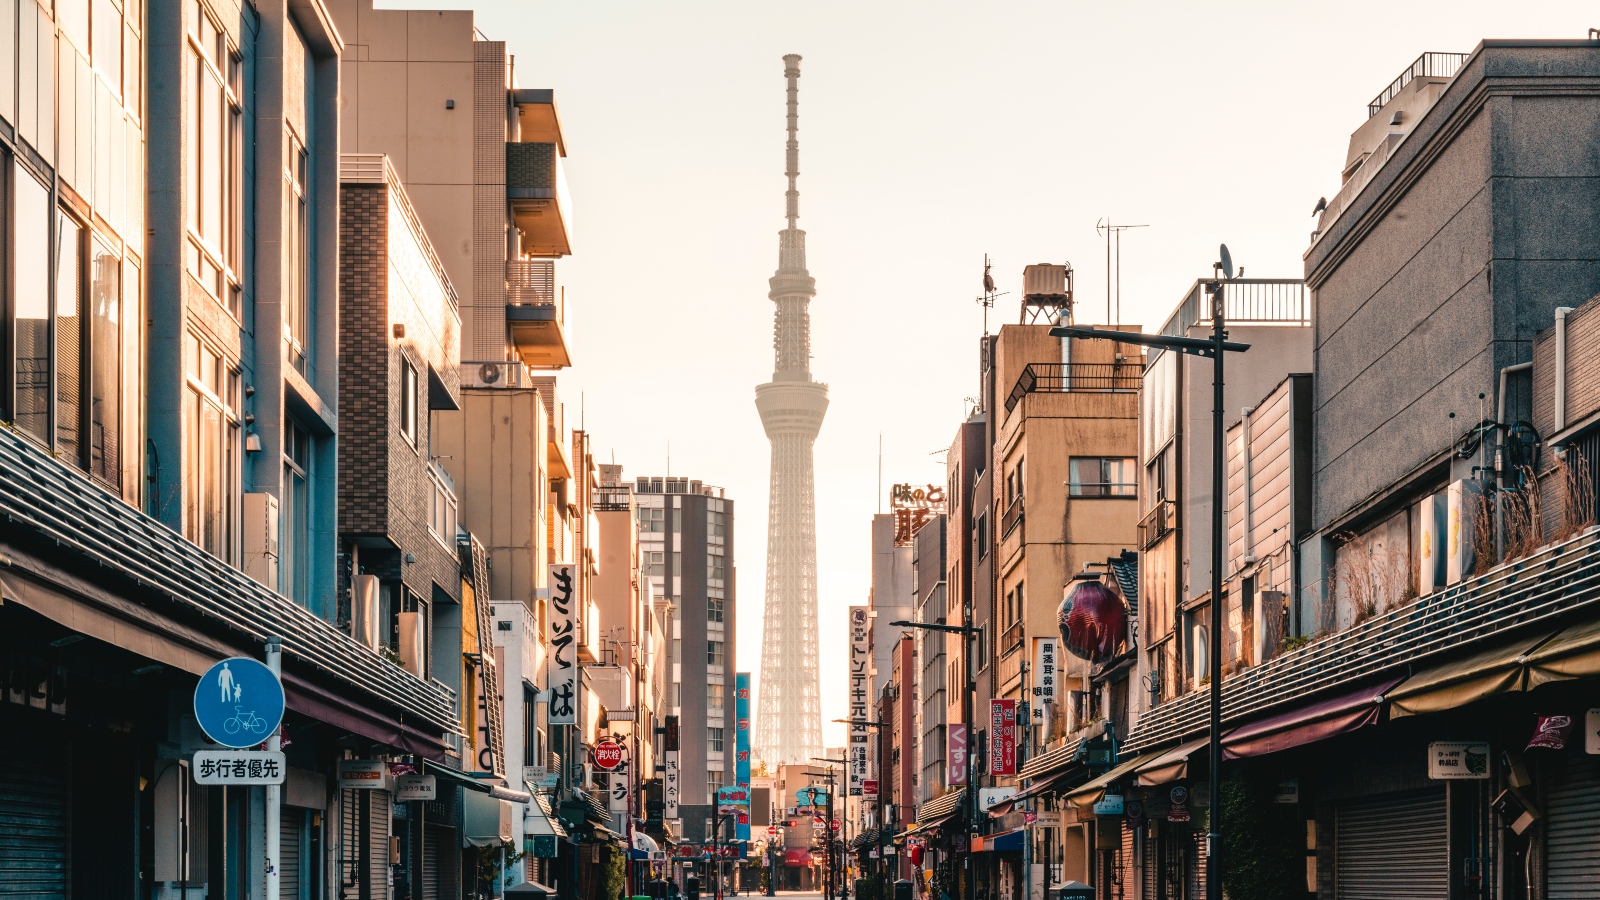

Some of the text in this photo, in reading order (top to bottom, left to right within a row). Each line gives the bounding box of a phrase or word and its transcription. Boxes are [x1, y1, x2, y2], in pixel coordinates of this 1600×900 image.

[550, 567, 574, 717] きそば
[851, 644, 866, 732] トンテキ元気
[1032, 687, 1043, 719] 眼科
[597, 749, 621, 760] 消火栓
[951, 727, 967, 783] くすり
[993, 703, 1003, 772] 韓国家庭料理
[200, 758, 279, 778] 歩行者優先
[667, 760, 677, 809] 浅草今半
